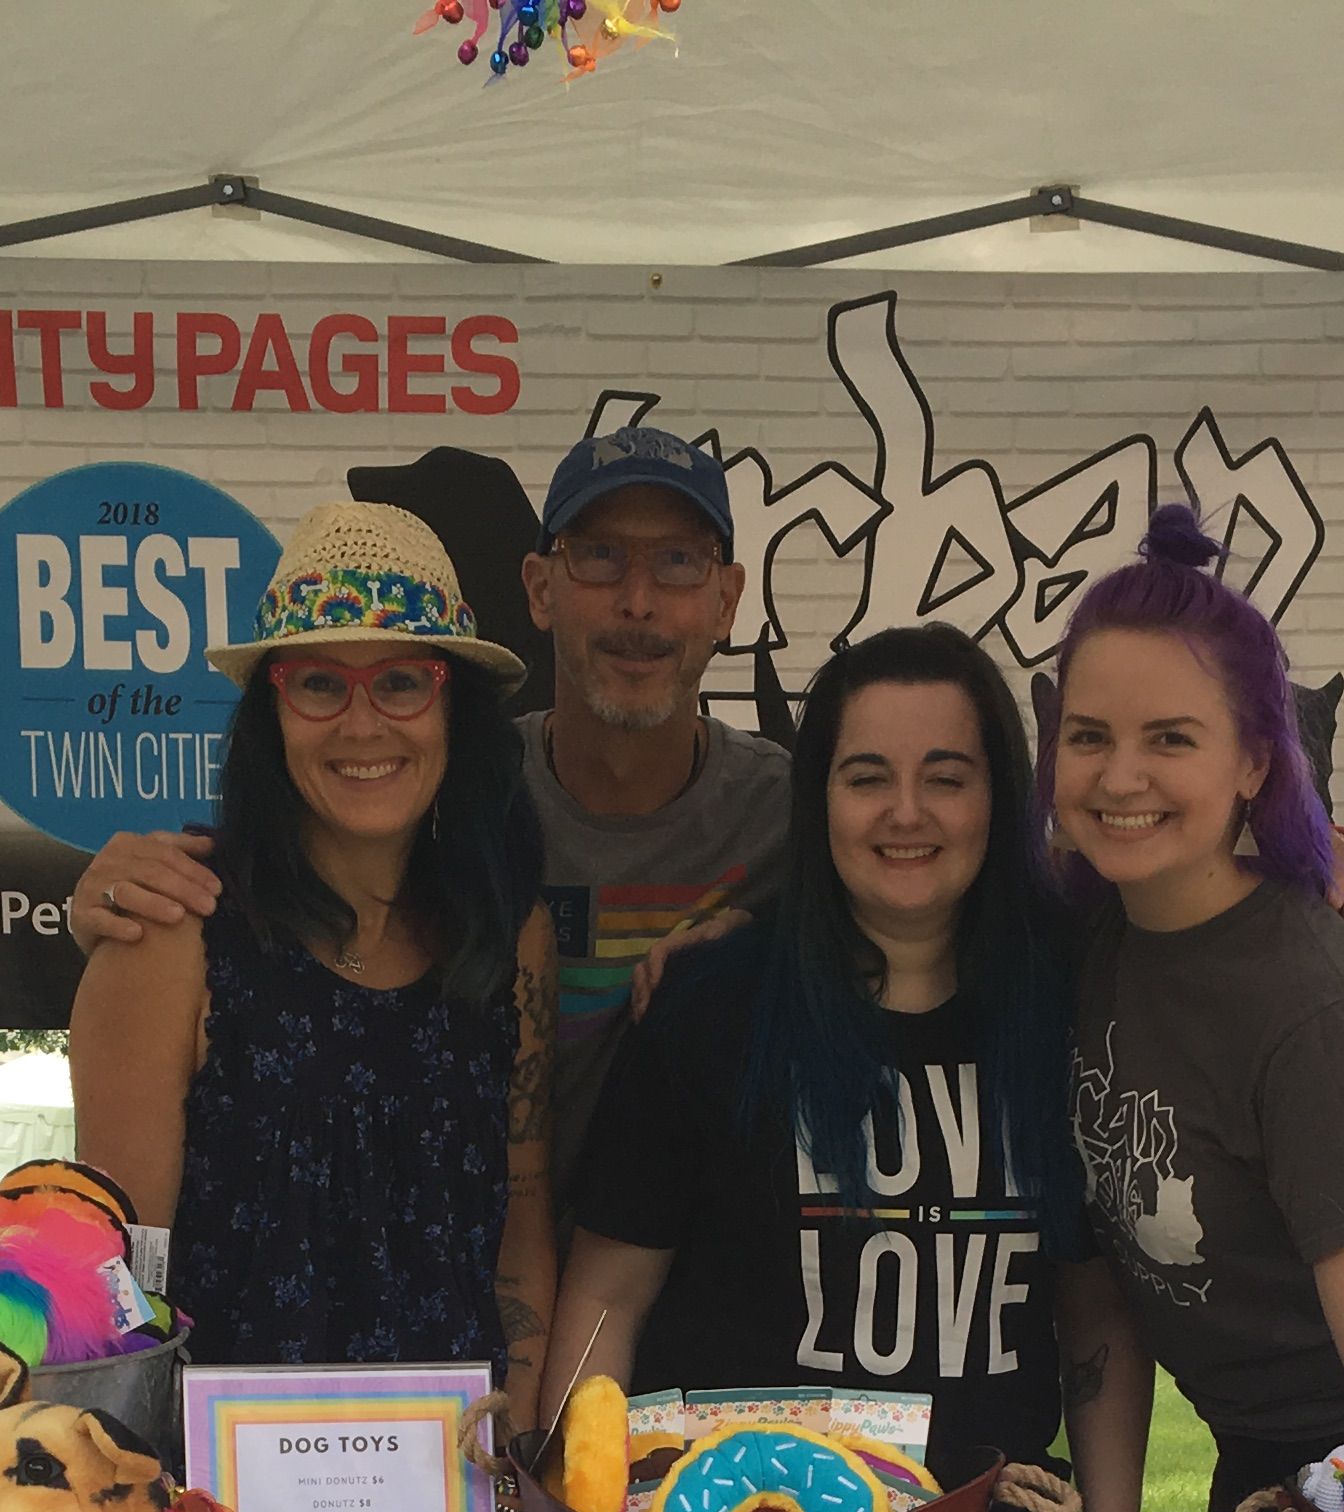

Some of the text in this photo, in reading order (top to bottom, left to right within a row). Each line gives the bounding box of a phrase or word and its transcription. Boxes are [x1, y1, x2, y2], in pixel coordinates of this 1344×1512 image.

[176, 312, 520, 414] PAGES
[97, 501, 160, 528] 2018
[15, 533, 240, 673] BEST
[87, 685, 183, 725] of the
[20, 729, 223, 801] TWIN CITIE
[918, 1205, 941, 1222] IS
[797, 1229, 1040, 1378] LOVE
[279, 1435, 400, 1455] DOG TOYS
[298, 1474, 385, 1486] MINI DONUTZ $6
[312, 1498, 372, 1509] DONUTZ $8
